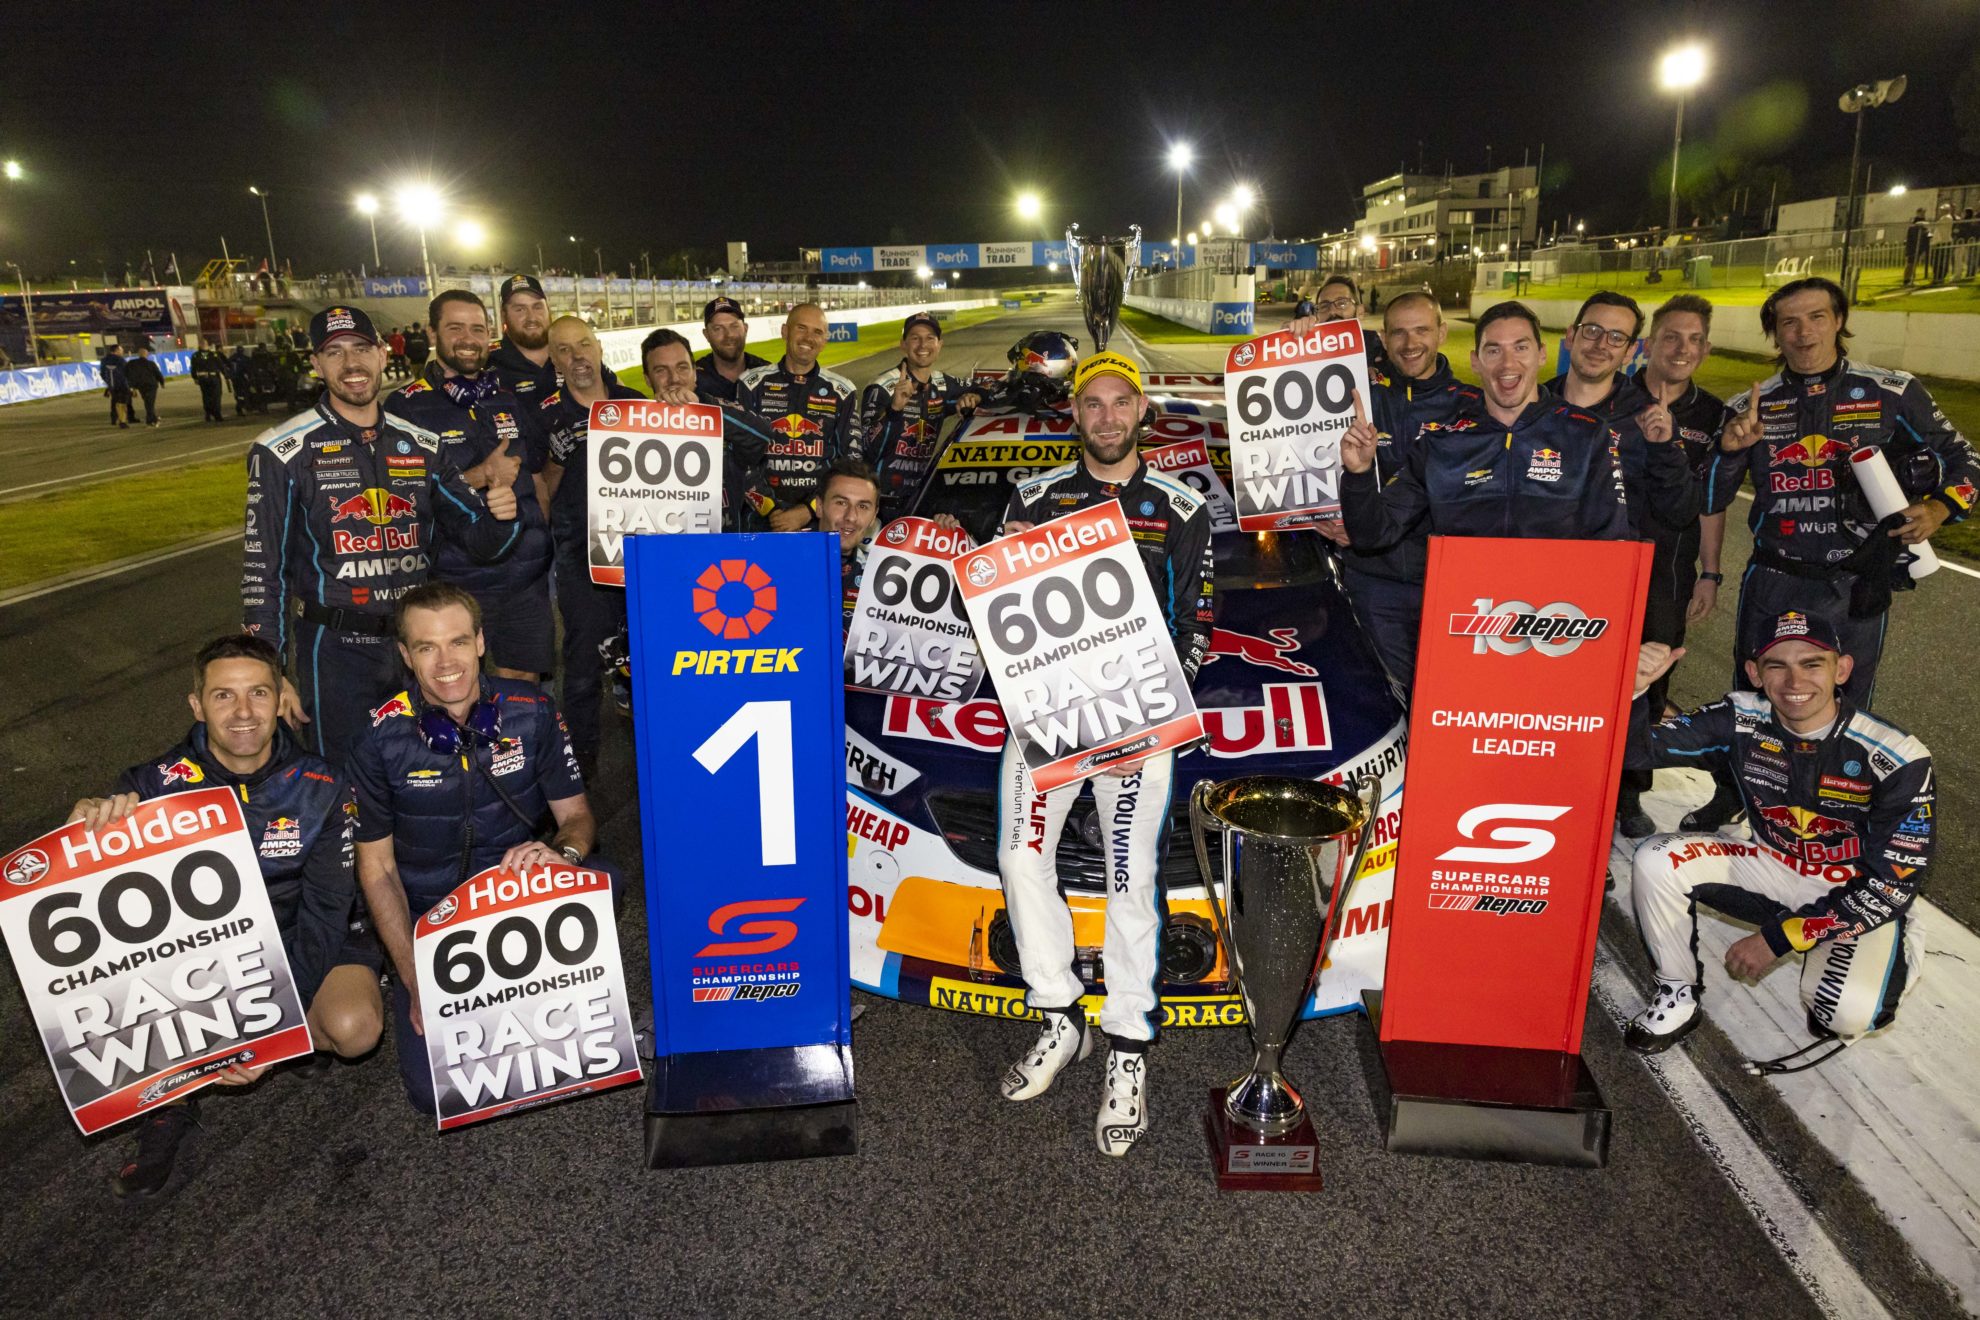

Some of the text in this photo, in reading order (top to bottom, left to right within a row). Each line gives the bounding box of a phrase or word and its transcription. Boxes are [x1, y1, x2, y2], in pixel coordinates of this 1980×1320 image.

[831, 254, 862, 267] Perth
[881, 250, 920, 258] BUNNINGS
[936, 249, 969, 264] Perth
[986, 246, 1026, 255] BUNNINGS
[987, 254, 1016, 264] TRADE
[881, 257, 910, 267] TRADE
[372, 282, 408, 297] Perth
[112, 298, 165, 311] AMPOL
[1215, 305, 1253, 326] Perth
[825, 325, 851, 341] erth
[1262, 330, 1355, 362] Holden
[164, 353, 183, 375] Perth
[1080, 358, 1136, 376] DUNLOP
[1882, 377, 1904, 387] OMP
[1237, 363, 1356, 426] 600
[628, 405, 714, 431] Holden
[277, 438, 298, 454] OMP
[417, 434, 437, 447] OMP
[795, 440, 823, 456] Bull
[598, 436, 711, 487] 600
[1146, 449, 1202, 470] olden
[1241, 440, 1337, 480] RAC
[781, 477, 817, 487] WÜRTH
[943, 471, 998, 486] van
[1527, 467, 1563, 475] AMPOL
[1769, 469, 1815, 493] Red
[598, 487, 710, 502] CHAMPIONSHIP
[1022, 485, 1043, 499] OMP
[1243, 469, 1341, 511] WIN
[1173, 496, 1194, 513] OMP
[599, 503, 712, 534] RACE
[333, 523, 420, 554] Red Bull
[1002, 518, 1118, 574] Holden
[336, 554, 427, 579] AMPOL
[987, 557, 1135, 656] 600
[866, 606, 976, 640] CHAMPIONSHI
[1509, 612, 1609, 643] Repco
[857, 624, 979, 677] RACE
[1005, 616, 1148, 679] CHAMPIONSHIP
[671, 647, 804, 676] PIRTEK
[854, 656, 967, 700] WINS
[1018, 637, 1168, 725] RACE
[1023, 676, 1178, 759] WINS
[1202, 685, 1326, 753] ull
[1432, 710, 1604, 733] CHAMPIONSHIP
[1736, 715, 1757, 728] OMP
[1095, 741, 1147, 762] FINAL ROAR
[1472, 738, 1556, 758] LEADER
[491, 755, 526, 770] AMPOL
[1872, 753, 1896, 773] OMP
[303, 770, 335, 784] AMPOL
[692, 700, 797, 866] 1
[1751, 778, 1788, 793] AMPLIFY
[1823, 777, 1848, 788] Harvey
[1010, 762, 1026, 851] Premium Fuels
[1114, 791, 1139, 825] YOU
[60, 803, 228, 868] Holden
[259, 840, 303, 849] AMPOL
[260, 848, 301, 857] RACING
[1112, 827, 1131, 893] WINGS
[1805, 837, 1860, 863] Bull
[469, 866, 597, 910] Holden
[1430, 882, 1549, 896] CHAMPIONSHIP
[1431, 870, 1551, 887] SUPERCARS
[28, 849, 242, 968] 600
[1474, 895, 1549, 916] Repco
[47, 918, 255, 996] CHAMPIONSHIP
[433, 902, 599, 995] 600
[692, 962, 800, 976] SUPERCARS
[692, 972, 800, 985] CHAMPIONSHIP
[56, 941, 273, 1049] RACE
[438, 965, 605, 1019] CHAMPIONSHIP
[734, 983, 801, 1002] Repco
[69, 986, 284, 1089] WINS
[440, 987, 616, 1067] RACE
[167, 1056, 237, 1088] FINAL ROAR
[447, 1031, 622, 1108] WINS
